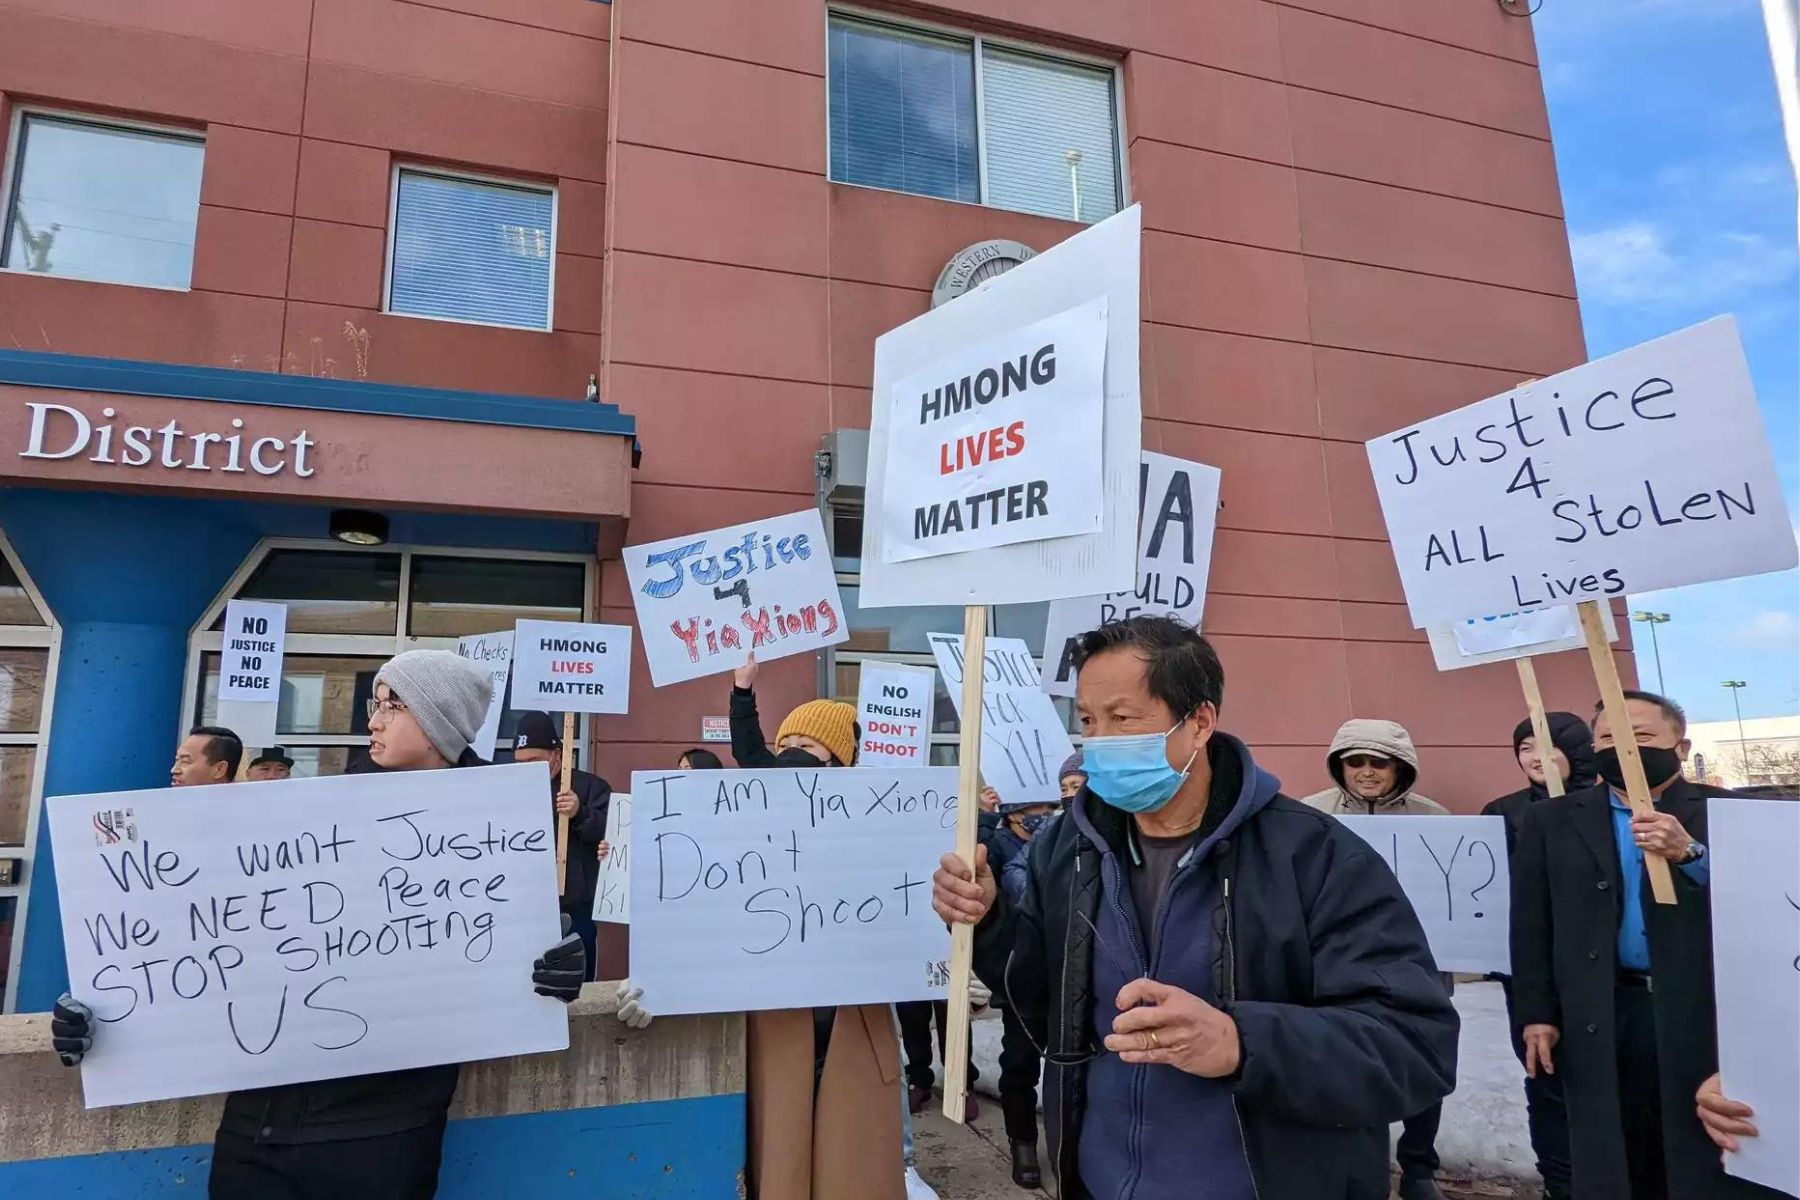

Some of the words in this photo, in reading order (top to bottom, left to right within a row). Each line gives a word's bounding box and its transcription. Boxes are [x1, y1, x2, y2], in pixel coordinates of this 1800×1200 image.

[920, 343, 1056, 425] HMONG
[19, 402, 314, 477] District
[940, 421, 1025, 475] LIVES
[1392, 377, 1676, 484] Justice
[1506, 457, 1550, 499] 4
[914, 480, 1049, 540] MATTER
[641, 531, 811, 598] Justice
[1425, 525, 1505, 571] ALL
[713, 578, 751, 608] 4
[1512, 568, 1625, 607] Lives
[230, 639, 275, 652] JUSTICE
[242, 616, 268, 635] NO
[540, 638, 607, 654] HMONG
[670, 616, 742, 663] Yia
[741, 599, 838, 649] Xiong
[241, 656, 262, 671] NO
[474, 638, 508, 661] Checks
[552, 661, 594, 674] LIVES
[229, 674, 270, 689] PEACE
[538, 681, 604, 695] MATTER
[883, 685, 908, 699] NO
[866, 703, 921, 718] ENGLISH
[868, 721, 917, 737] DON'T
[864, 740, 917, 757] SHOOT
[644, 775, 686, 821] I
[714, 778, 768, 815] AM
[795, 772, 850, 827] Yia
[102, 840, 199, 892] We
[237, 825, 355, 876] want
[377, 809, 548, 862] Justice
[655, 830, 801, 902] Don't
[85, 912, 159, 956] We
[191, 882, 344, 940] NEED
[380, 867, 509, 913] Peace
[741, 872, 926, 954] Shoot
[92, 945, 243, 1022] STOP
[228, 976, 368, 1054] US
